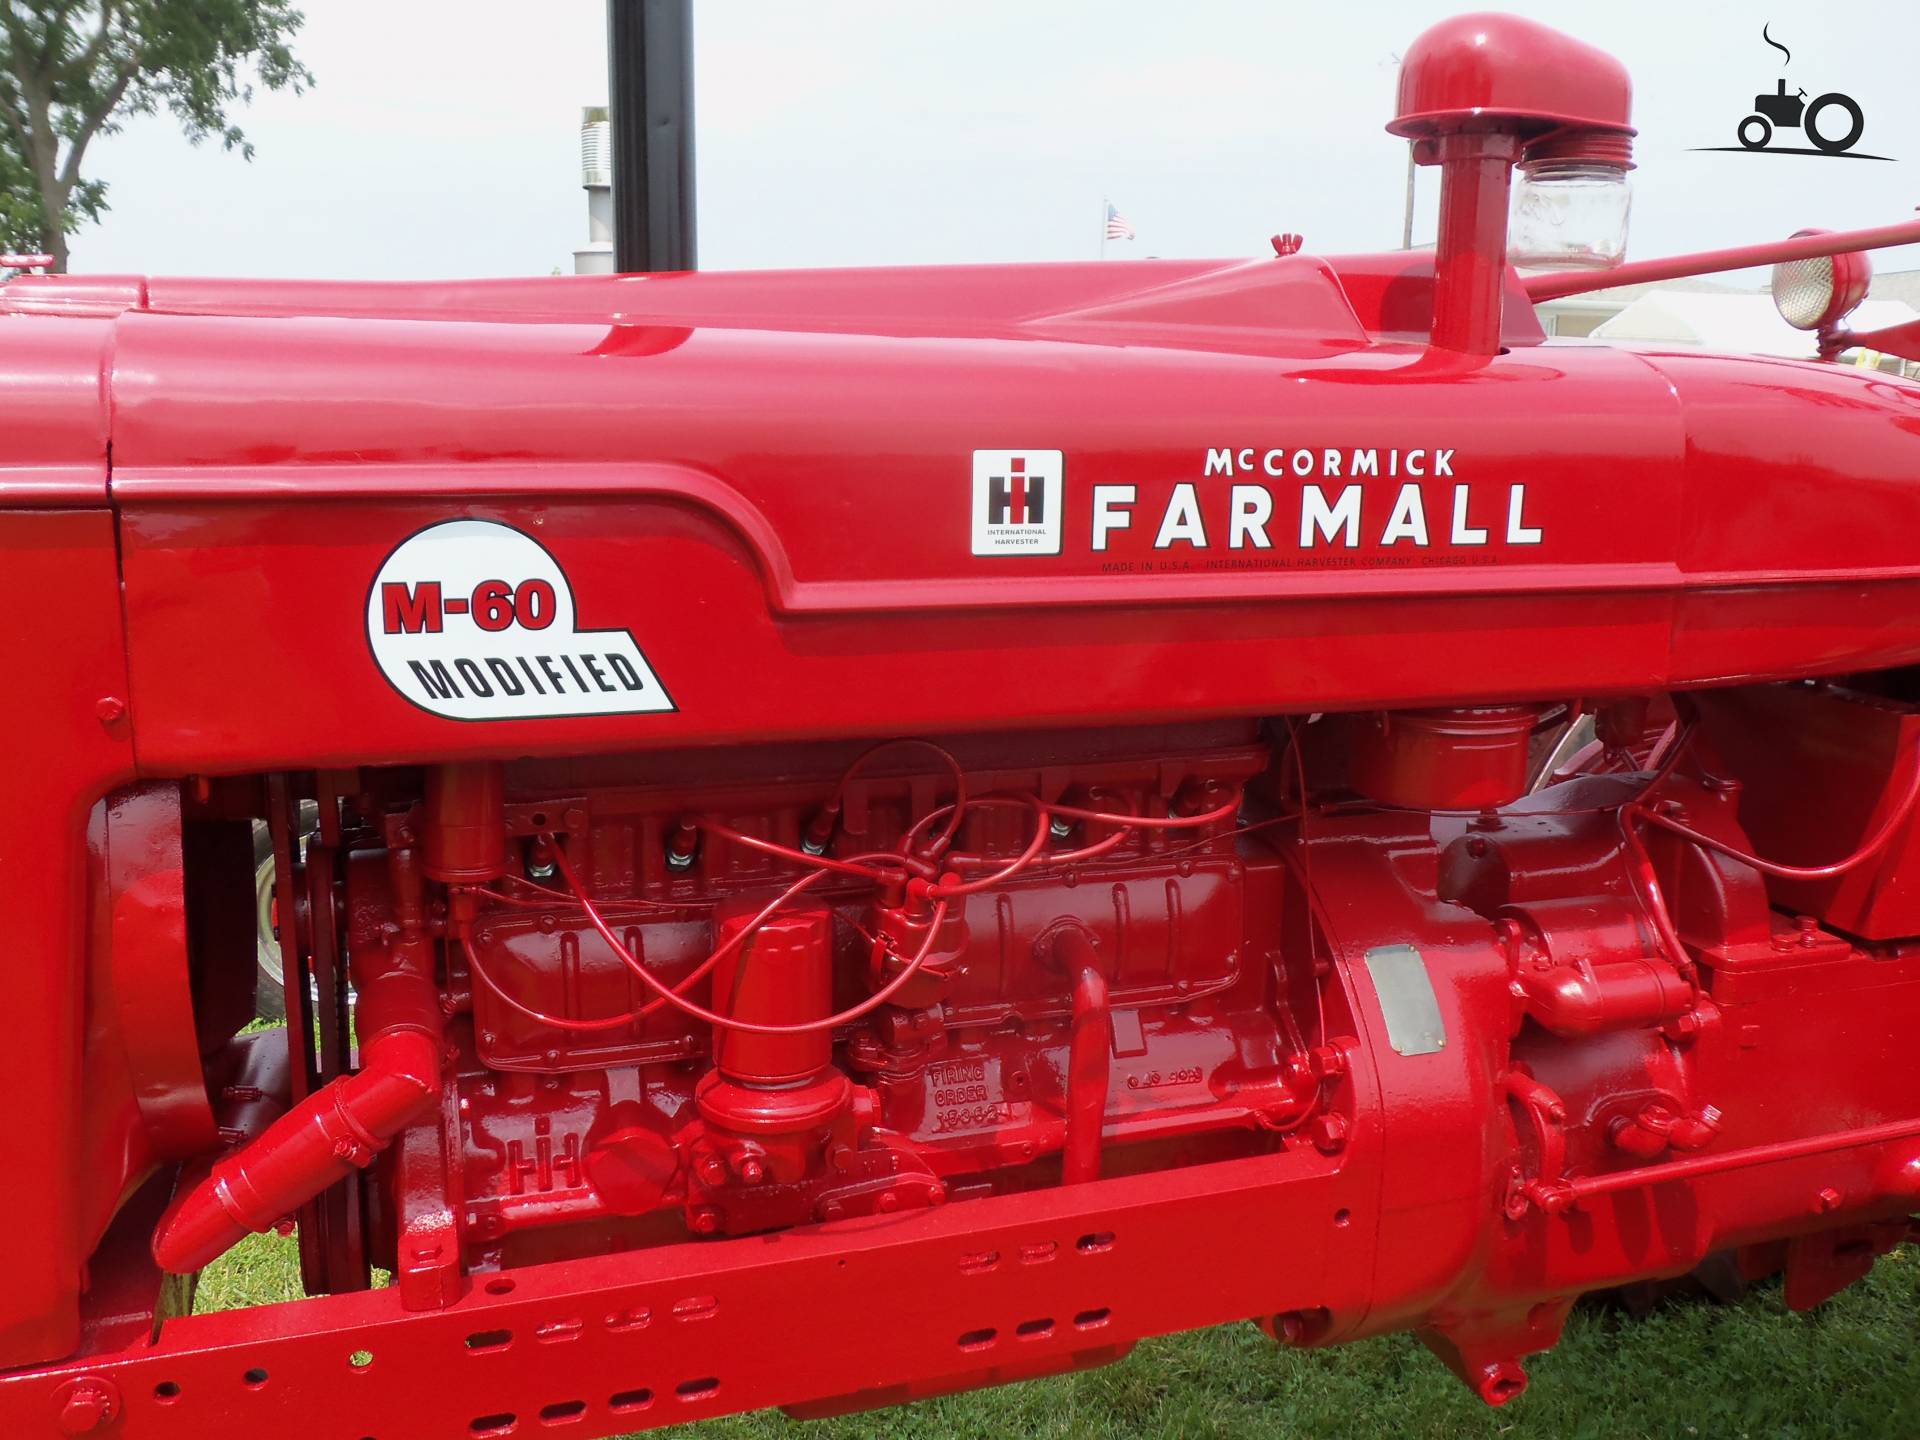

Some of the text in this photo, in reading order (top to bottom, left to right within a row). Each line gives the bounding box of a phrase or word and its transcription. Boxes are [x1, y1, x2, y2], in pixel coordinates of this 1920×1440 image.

[1090, 482, 1544, 551] FARMALL
[1102, 562, 1135, 572] MADE
[1141, 562, 1153, 571] IN
[1206, 559, 1292, 569] INTERNATIONAL
[1296, 557, 1356, 567] HARVESTER
[1360, 556, 1412, 566] COMPANY
[381, 578, 557, 634] M-60
[406, 652, 645, 700] MODIFIED
[930, 1063, 985, 1087] FIRING
[935, 1084, 988, 1107] ORDER
